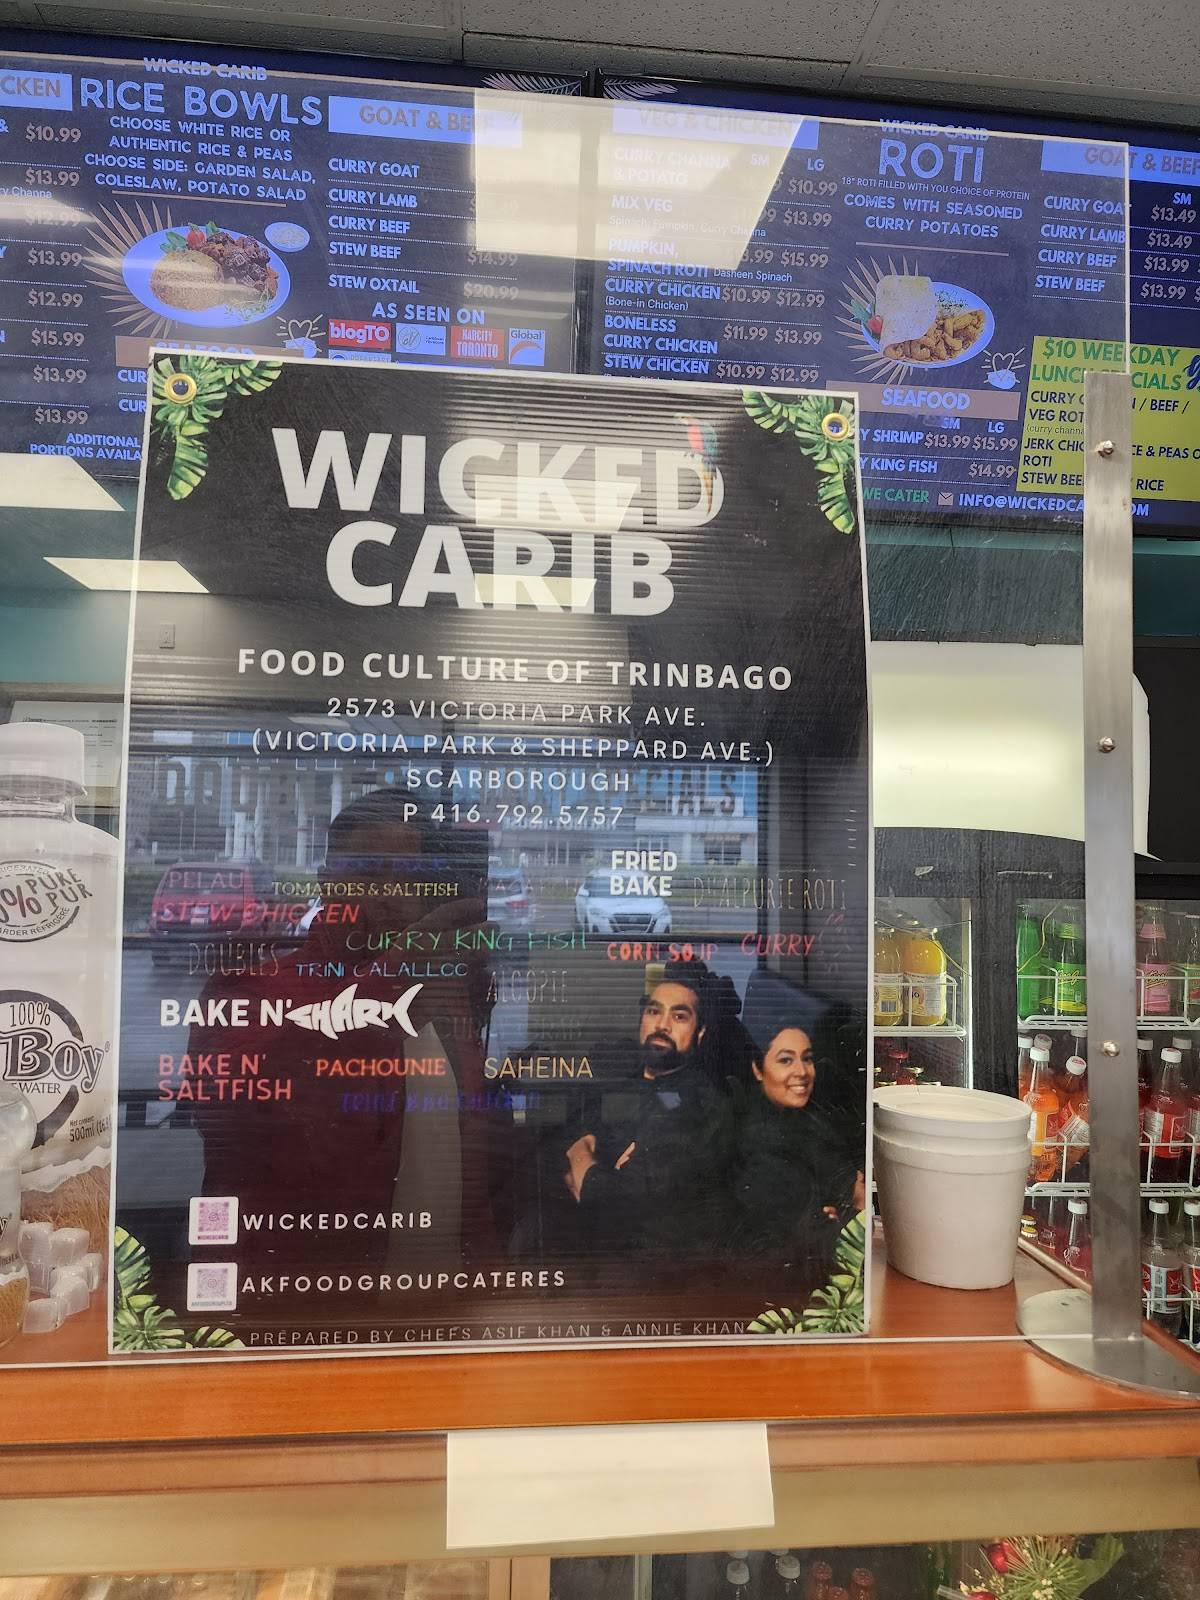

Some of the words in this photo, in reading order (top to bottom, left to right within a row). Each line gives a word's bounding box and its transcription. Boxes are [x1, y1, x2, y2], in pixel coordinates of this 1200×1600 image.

[80, 78, 165, 113] RICE
[184, 85, 323, 126] BOWLS
[359, 105, 421, 128] GOAT
[25, 123, 81, 143] $10.99
[110, 115, 171, 132] CHOOSE
[178, 121, 225, 137] WHITE
[230, 123, 263, 139] RICE
[269, 126, 290, 142] OR
[109, 135, 191, 153] AUTHENTIC
[198, 141, 230, 156] RICE
[254, 146, 292, 162] PEAS
[85, 153, 146, 170] CHOOSE
[152, 157, 188, 173] SIDE:
[195, 161, 256, 178] GARDEN
[328, 158, 377, 174] CURRY
[380, 162, 420, 178] GOAT
[807, 158, 825, 172] LG
[879, 138, 984, 184] ROTI
[25, 167, 80, 187] $13.99
[788, 177, 837, 197] $10.99
[188, 180, 251, 197] POTATO
[328, 188, 377, 204] CURRY
[380, 192, 418, 208] LAMB
[857, 178, 877, 188] ROTI
[878, 180, 906, 189] FILLED
[907, 182, 929, 192] WITH
[930, 184, 948, 193] YOU
[950, 186, 981, 196] CHOICE
[996, 190, 1030, 200] PROTEIN
[1173, 192, 1192, 205] SM
[844, 193, 896, 209] COMES
[903, 198, 940, 213] WITH
[946, 202, 1023, 220] SEASONED
[1044, 195, 1091, 212] CURRY
[783, 207, 832, 226] $13.99
[1151, 205, 1197, 223] $13.49
[328, 215, 376, 231] CURRY
[380, 219, 411, 234] BEEF
[865, 216, 914, 231] CURRY
[920, 219, 999, 237] POTATOES
[1040, 224, 1087, 241] CURRY
[328, 241, 367, 256] STEW
[370, 245, 402, 259] BEEF
[1147, 231, 1193, 249] $13.49
[28, 248, 82, 268] $13.99
[780, 249, 829, 269] $15.99
[1038, 249, 1085, 265] CURRY
[1087, 253, 1117, 268] BEEF
[1144, 254, 1190, 273] $13.99
[328, 274, 367, 290] STEW
[370, 277, 420, 294] OXTAIL
[756, 270, 793, 283] Spinach
[1035, 275, 1074, 290] STEW
[1076, 278, 1105, 293] BEEF
[28, 290, 84, 308] $12.99
[605, 278, 654, 294] CURRY
[657, 281, 720, 300] CHICKEN
[722, 285, 771, 305] $10.99
[776, 289, 825, 308] $12.99
[1140, 282, 1186, 300] $13.99
[372, 302, 398, 319] AS
[404, 304, 450, 322] SEEN
[457, 308, 486, 325] ON
[648, 299, 689, 312] Chicken)
[31, 329, 85, 348] $15.99
[329, 322, 391, 343] blogTO
[511, 329, 542, 341] Global
[604, 315, 677, 333] BONELESS
[723, 323, 768, 342] $11.99
[774, 327, 822, 346] $13.99
[603, 333, 652, 350] CURRY
[655, 337, 718, 355] CHICKEN
[1042, 337, 1077, 360] $10
[32, 366, 87, 385] $13.99
[604, 354, 643, 370] STEW
[647, 357, 710, 375] CHICKEN
[716, 361, 766, 379] $10.99
[770, 365, 819, 384] $12.99
[881, 388, 970, 410] SEAFOOD
[1031, 390, 1075, 405] CURRY
[1150, 399, 1180, 413] BEEF
[34, 407, 88, 426] $13.99
[1029, 408, 1056, 421] VEG
[988, 421, 1005, 434] LG
[66, 433, 141, 448] ADDITIONAL
[872, 430, 924, 445] SHRIMP
[924, 432, 970, 449] $13.99
[972, 435, 1018, 452] $15.99
[1024, 438, 1054, 450] JERK
[1023, 455, 1052, 467] ROTI
[1158, 446, 1189, 459] PEAS
[271, 427, 725, 528] WICKED
[871, 459, 906, 472] KING
[908, 461, 938, 474] FISH
[968, 462, 1016, 479] $14.99
[1021, 471, 1057, 485] STEW
[1136, 479, 1165, 491] RICE
[885, 489, 930, 503] CATER
[325, 520, 675, 616] CARIB
[238, 648, 345, 677] FOOD
[363, 653, 529, 683] CULTURE
[547, 660, 590, 685] OF
[606, 661, 792, 691] TRINBAGO
[328, 698, 396, 718] 2573
[410, 700, 548, 723] VICTORIA
[561, 704, 632, 724] PARK
[644, 707, 705, 727] AVE.
[252, 728, 409, 755] (VICTORIA
[423, 735, 496, 755] PARK
[510, 737, 527, 755] &
[542, 738, 688, 760] SHEPPARD
[701, 741, 773, 767] AVE.)
[407, 768, 630, 792] SCARBOROUGH
[403, 803, 418, 823] P
[430, 803, 623, 826] 416.792.5757
[611, 850, 678, 872] FRIED
[25, 868, 82, 894] PURE
[169, 871, 244, 889] PELAU
[272, 881, 365, 897] TOMATOES
[367, 884, 381, 897] &
[383, 882, 459, 897] SALTFISH
[609, 875, 673, 897] BAKE
[45, 883, 93, 908] PUR
[346, 930, 442, 951] CURRY
[455, 929, 513, 951] KING
[528, 929, 586, 950] FISH
[741, 933, 816, 957] CURRY
[296, 962, 345, 977] TRINI
[10, 1002, 51, 1028] 100%
[160, 999, 249, 1027] BAKE
[260, 999, 293, 1027] N'
[285, 983, 424, 1040] SHARK
[159, 1054, 231, 1076] BAKE
[241, 1054, 267, 1076] N'
[315, 1058, 447, 1077] PACHOUNIE
[484, 1056, 594, 1080] SAHEINA
[19, 1082, 61, 1095] WATER
[158, 1079, 292, 1101] SALTFISH
[243, 1211, 433, 1232] WICKEDCARIB
[241, 1270, 566, 1294] AKFOODGROUPCATERES
[250, 1330, 359, 1346] PREPARED
[370, 1329, 394, 1344] BY
[404, 1327, 472, 1342] CHEFS
[482, 1326, 526, 1340] ASIF
[537, 1324, 591, 1338] KHAN
[601, 1324, 612, 1337] &
[622, 1322, 682, 1337] ANNIE
[693, 1321, 745, 1335] KHAN
